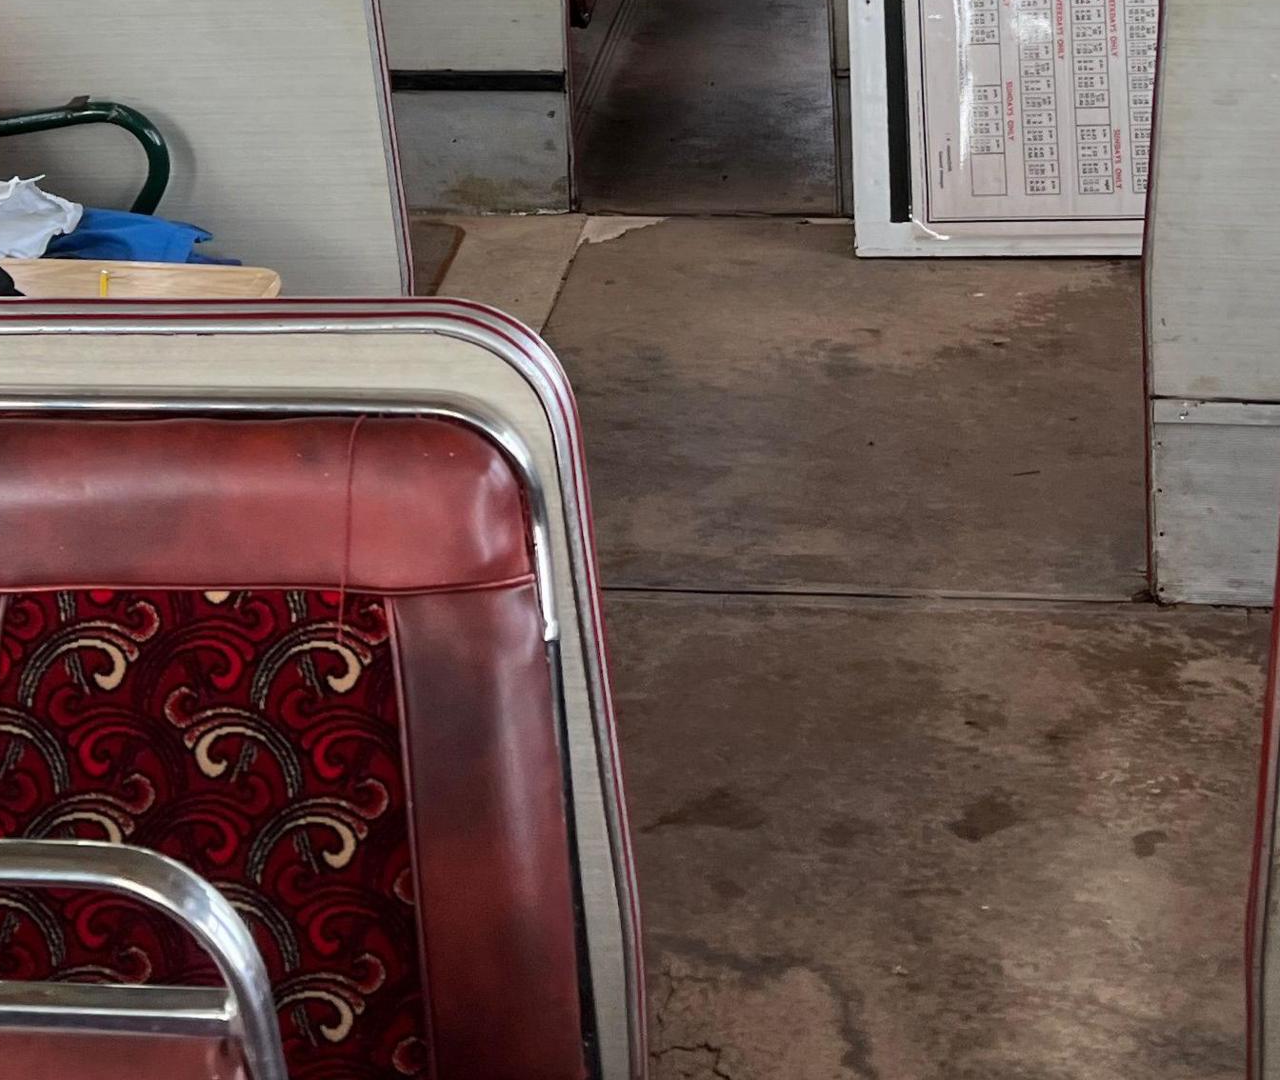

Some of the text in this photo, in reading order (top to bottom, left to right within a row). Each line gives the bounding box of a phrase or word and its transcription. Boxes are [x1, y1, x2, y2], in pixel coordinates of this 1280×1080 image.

[1056, 39, 1065, 60] ONLY
[1109, 36, 1118, 57] ONLY
[1114, 168, 1122, 190] ONLY
